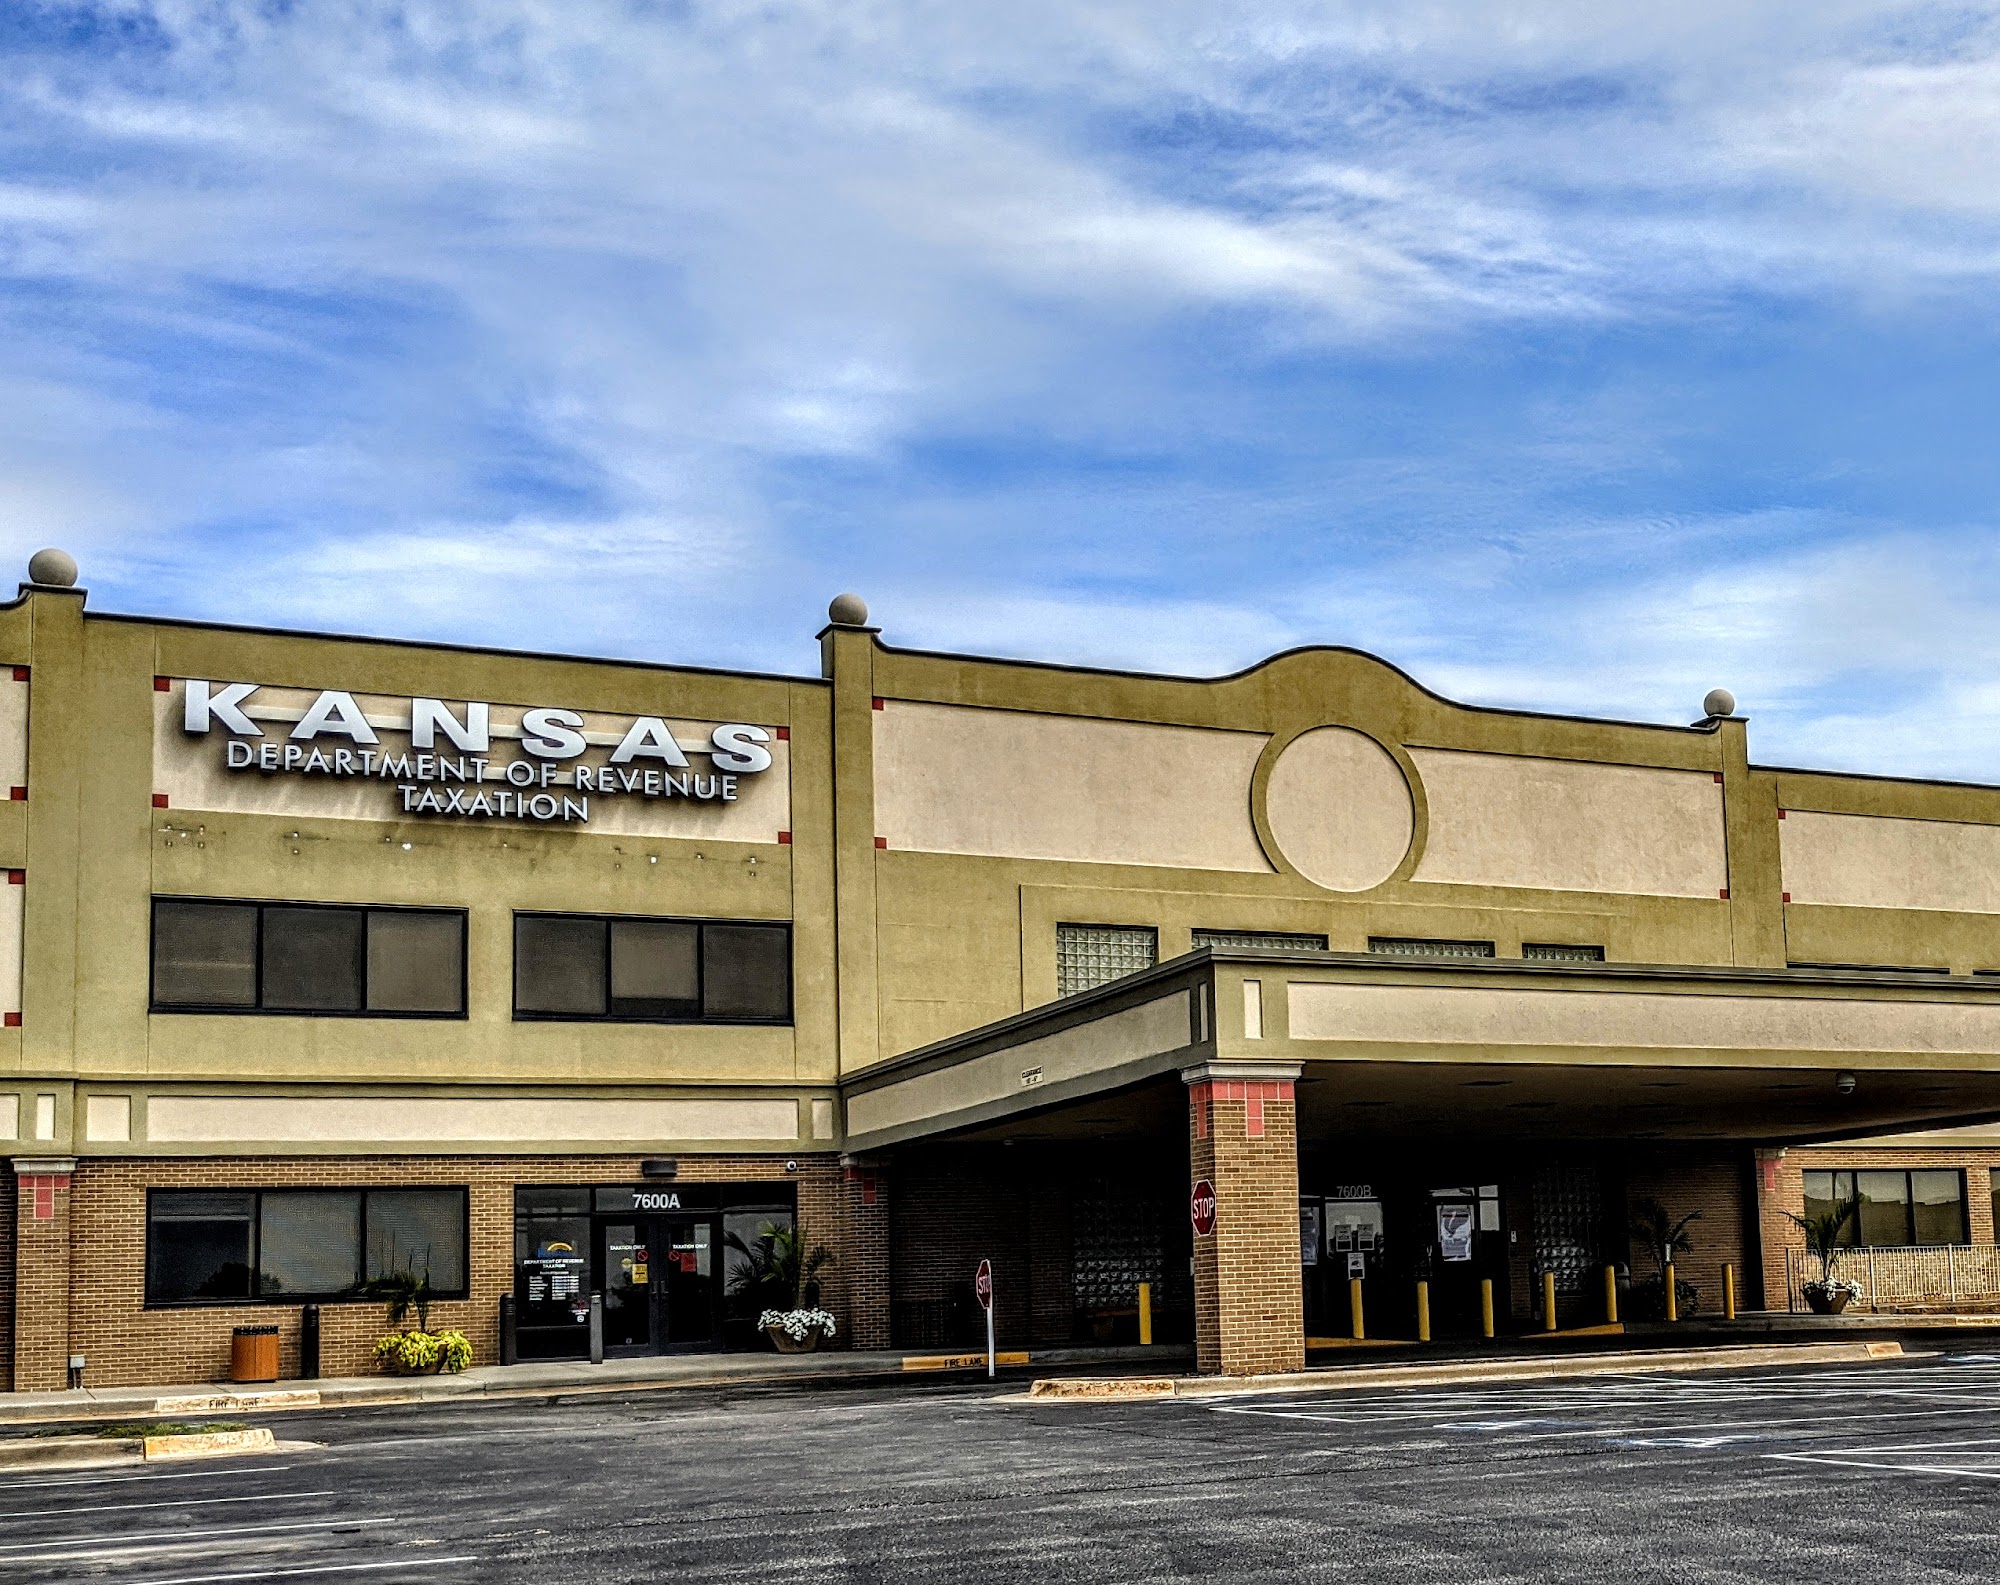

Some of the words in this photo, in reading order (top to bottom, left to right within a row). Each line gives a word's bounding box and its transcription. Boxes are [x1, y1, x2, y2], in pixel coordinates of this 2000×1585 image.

[183, 678, 773, 773] KANSAS
[226, 740, 490, 785] DEPARTMENT
[505, 760, 558, 789] OF
[575, 763, 739, 801] REVENUE
[397, 783, 590, 823] TAXATION
[632, 1193, 681, 1209] 7600A
[1336, 1184, 1372, 1198] 7600B
[1193, 1197, 1215, 1220] STOP
